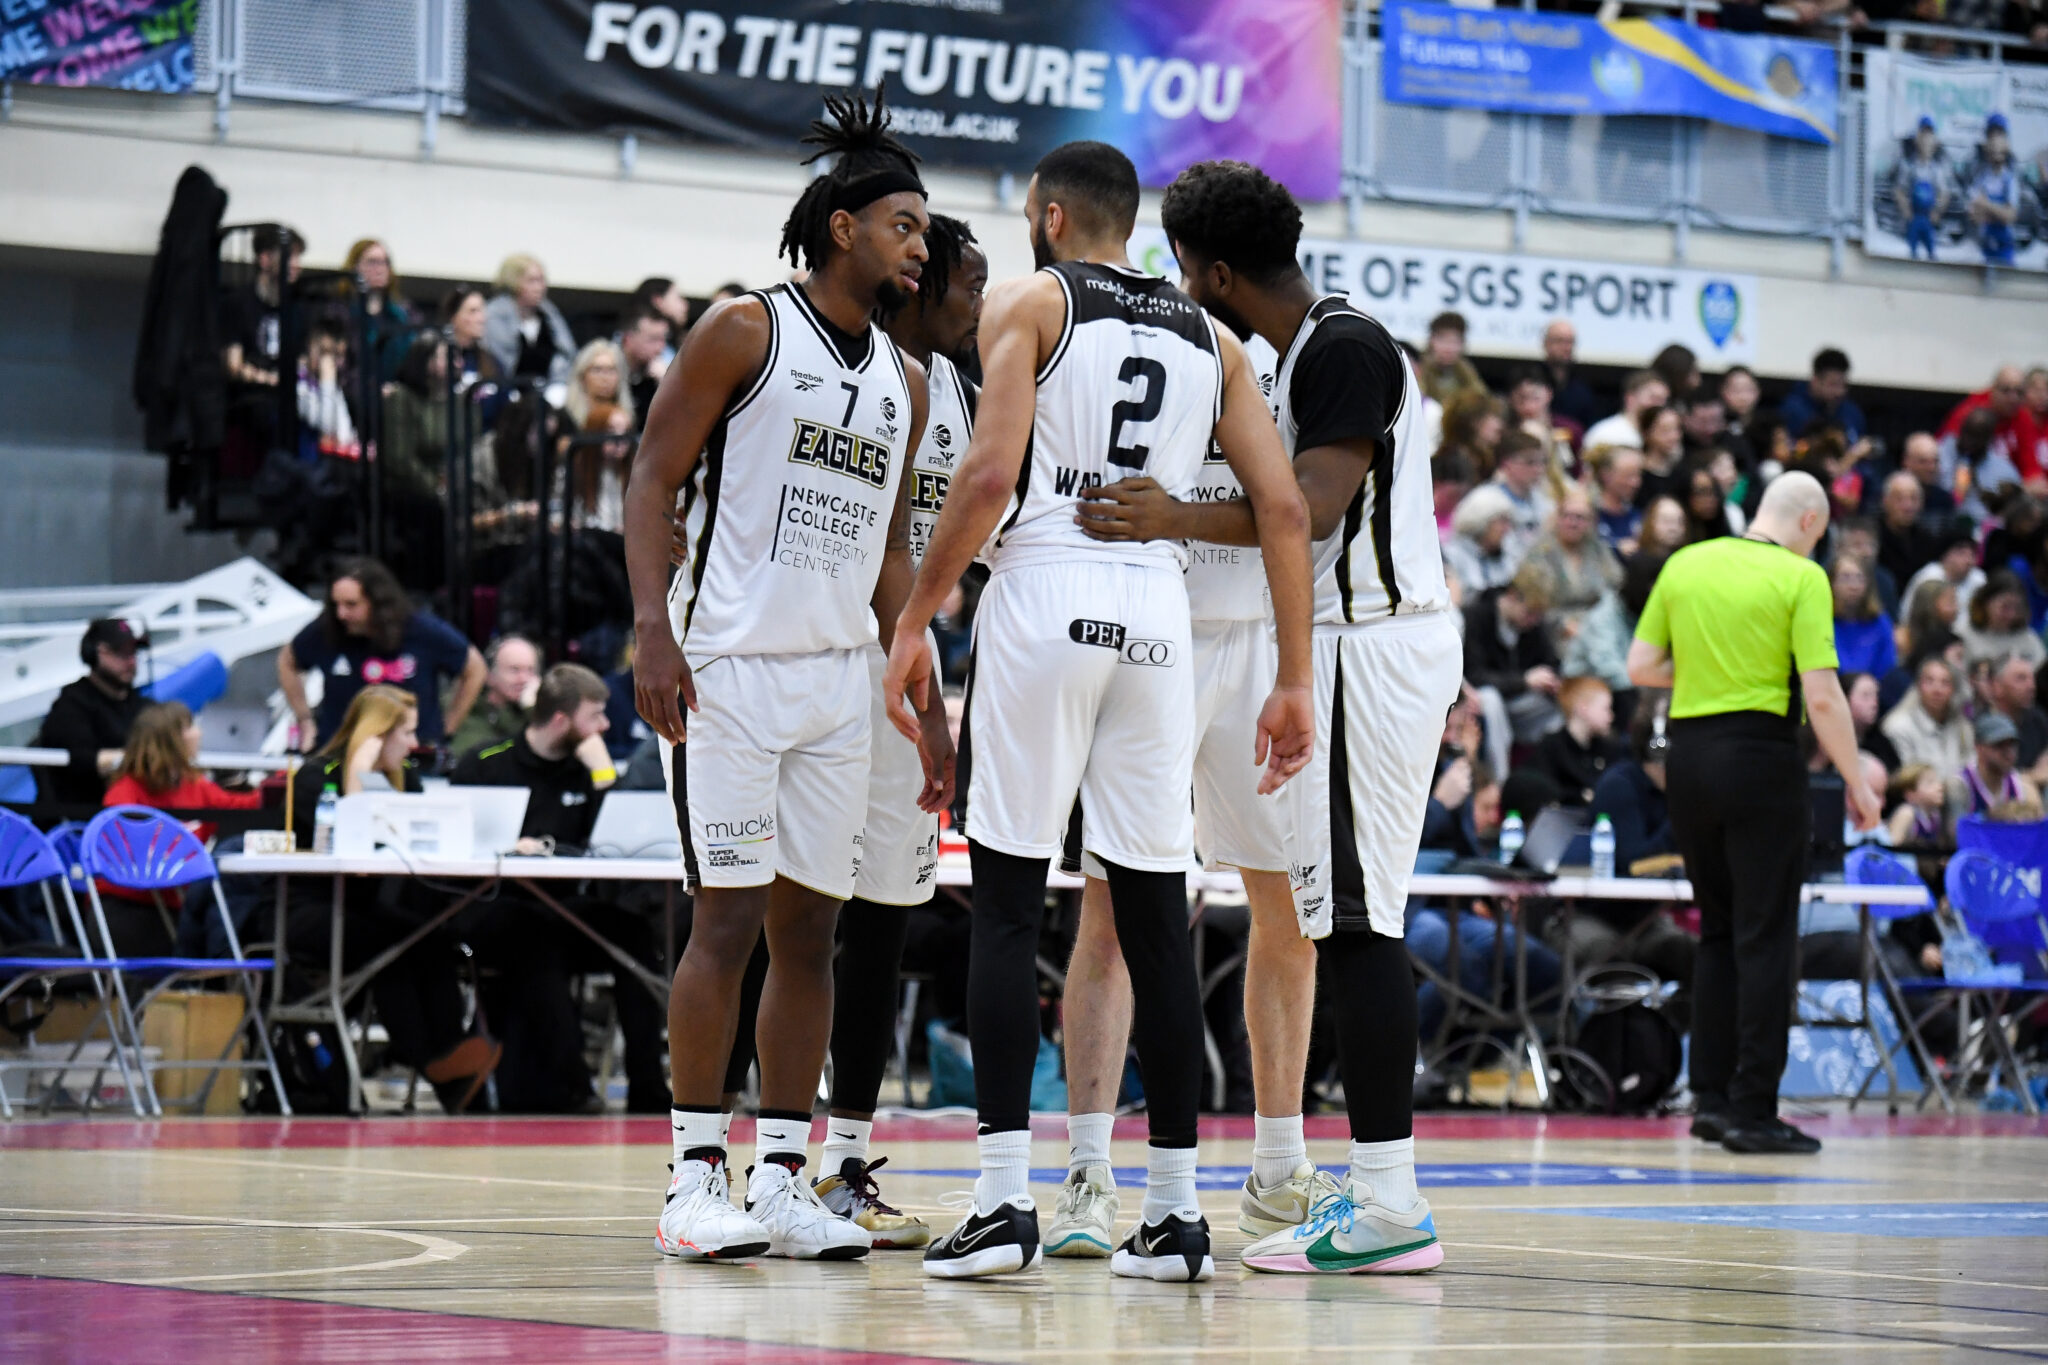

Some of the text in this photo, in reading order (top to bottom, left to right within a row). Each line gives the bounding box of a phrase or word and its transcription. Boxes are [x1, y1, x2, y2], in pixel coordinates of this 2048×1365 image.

[584, 1, 1244, 123] FOR THE FUTURE YOU
[1362, 257, 1423, 299] OF
[1440, 263, 1521, 309] SGS
[1539, 269, 1678, 320] SPORT
[790, 369, 824, 384] Reebok
[840, 380, 859, 428] 7
[1107, 356, 1167, 471] 2
[788, 418, 890, 490] EAGLES
[787, 507, 860, 541] COLLEGE
[779, 549, 841, 579] CENTRE
[783, 528, 868, 566] UNIVERSITY
[709, 858, 760, 867] BASKETBALL
